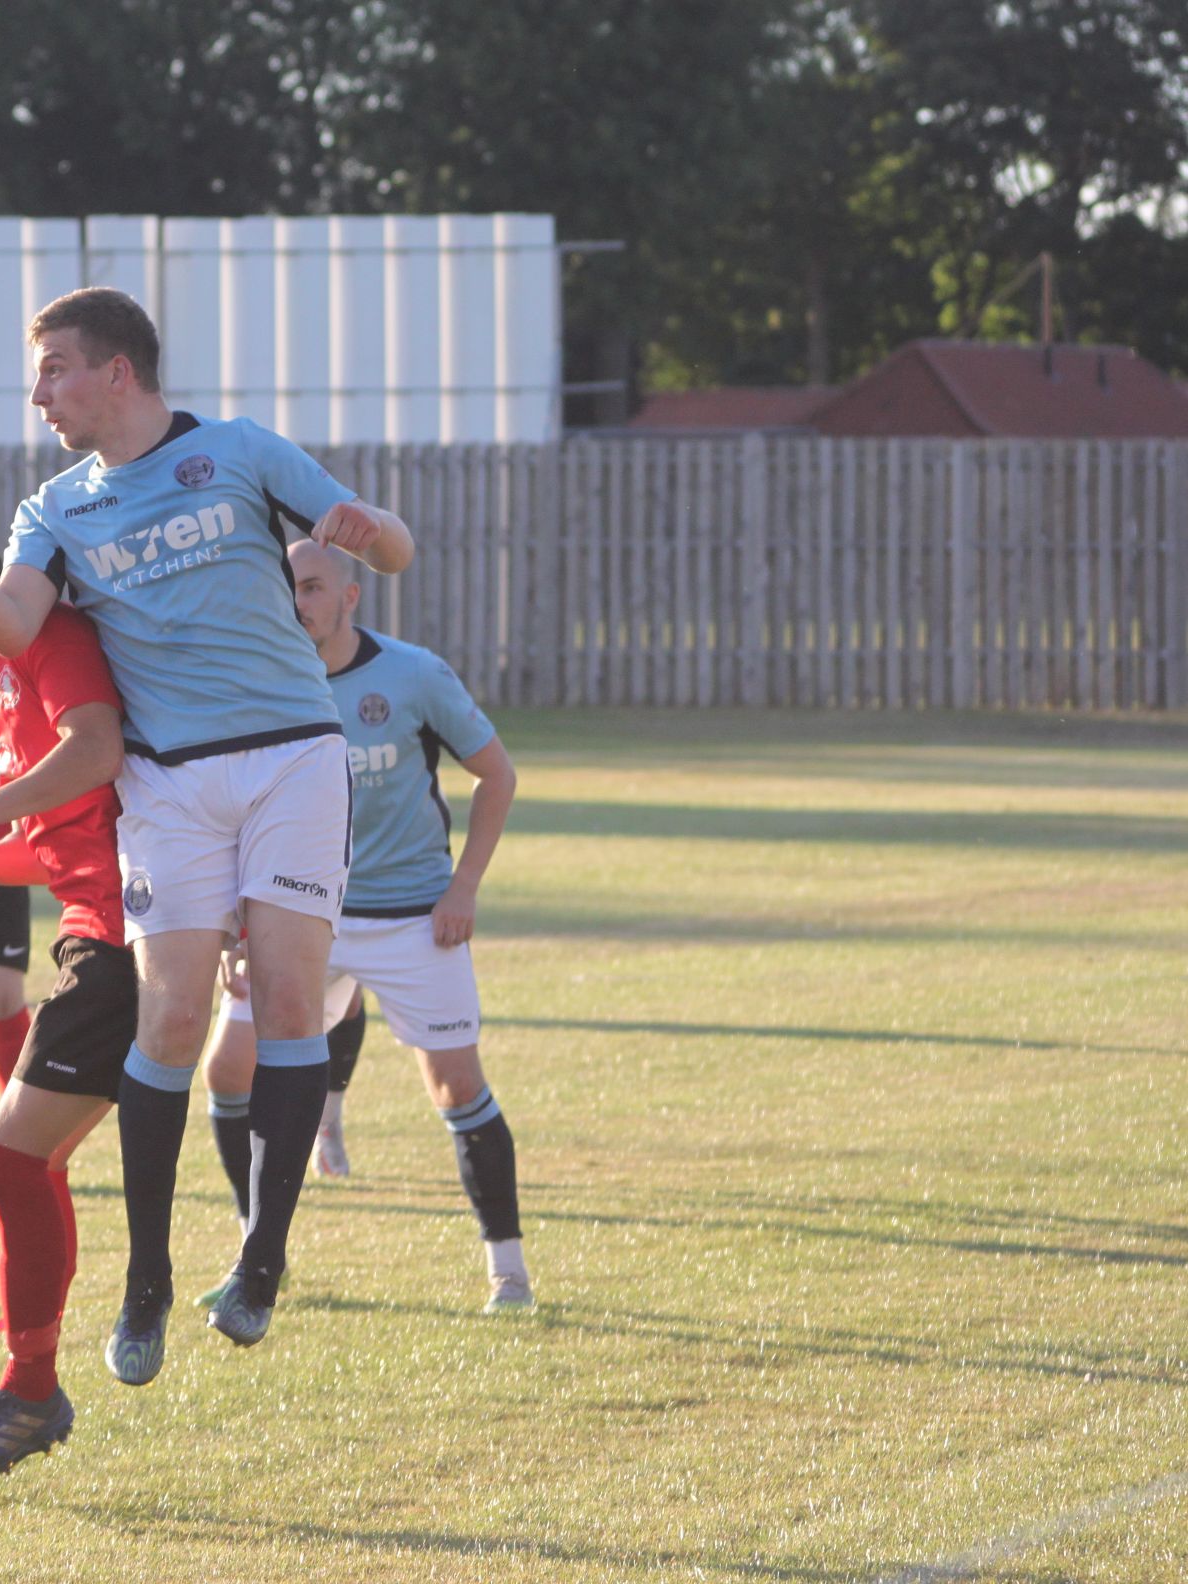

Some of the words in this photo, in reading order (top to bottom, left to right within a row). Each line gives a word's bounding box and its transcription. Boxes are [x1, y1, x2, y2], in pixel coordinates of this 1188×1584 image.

[65, 495, 118, 519] macron
[84, 502, 235, 579] wren
[113, 544, 221, 593] KITCHENS
[347, 743, 397, 772] en
[273, 874, 328, 899] macron
